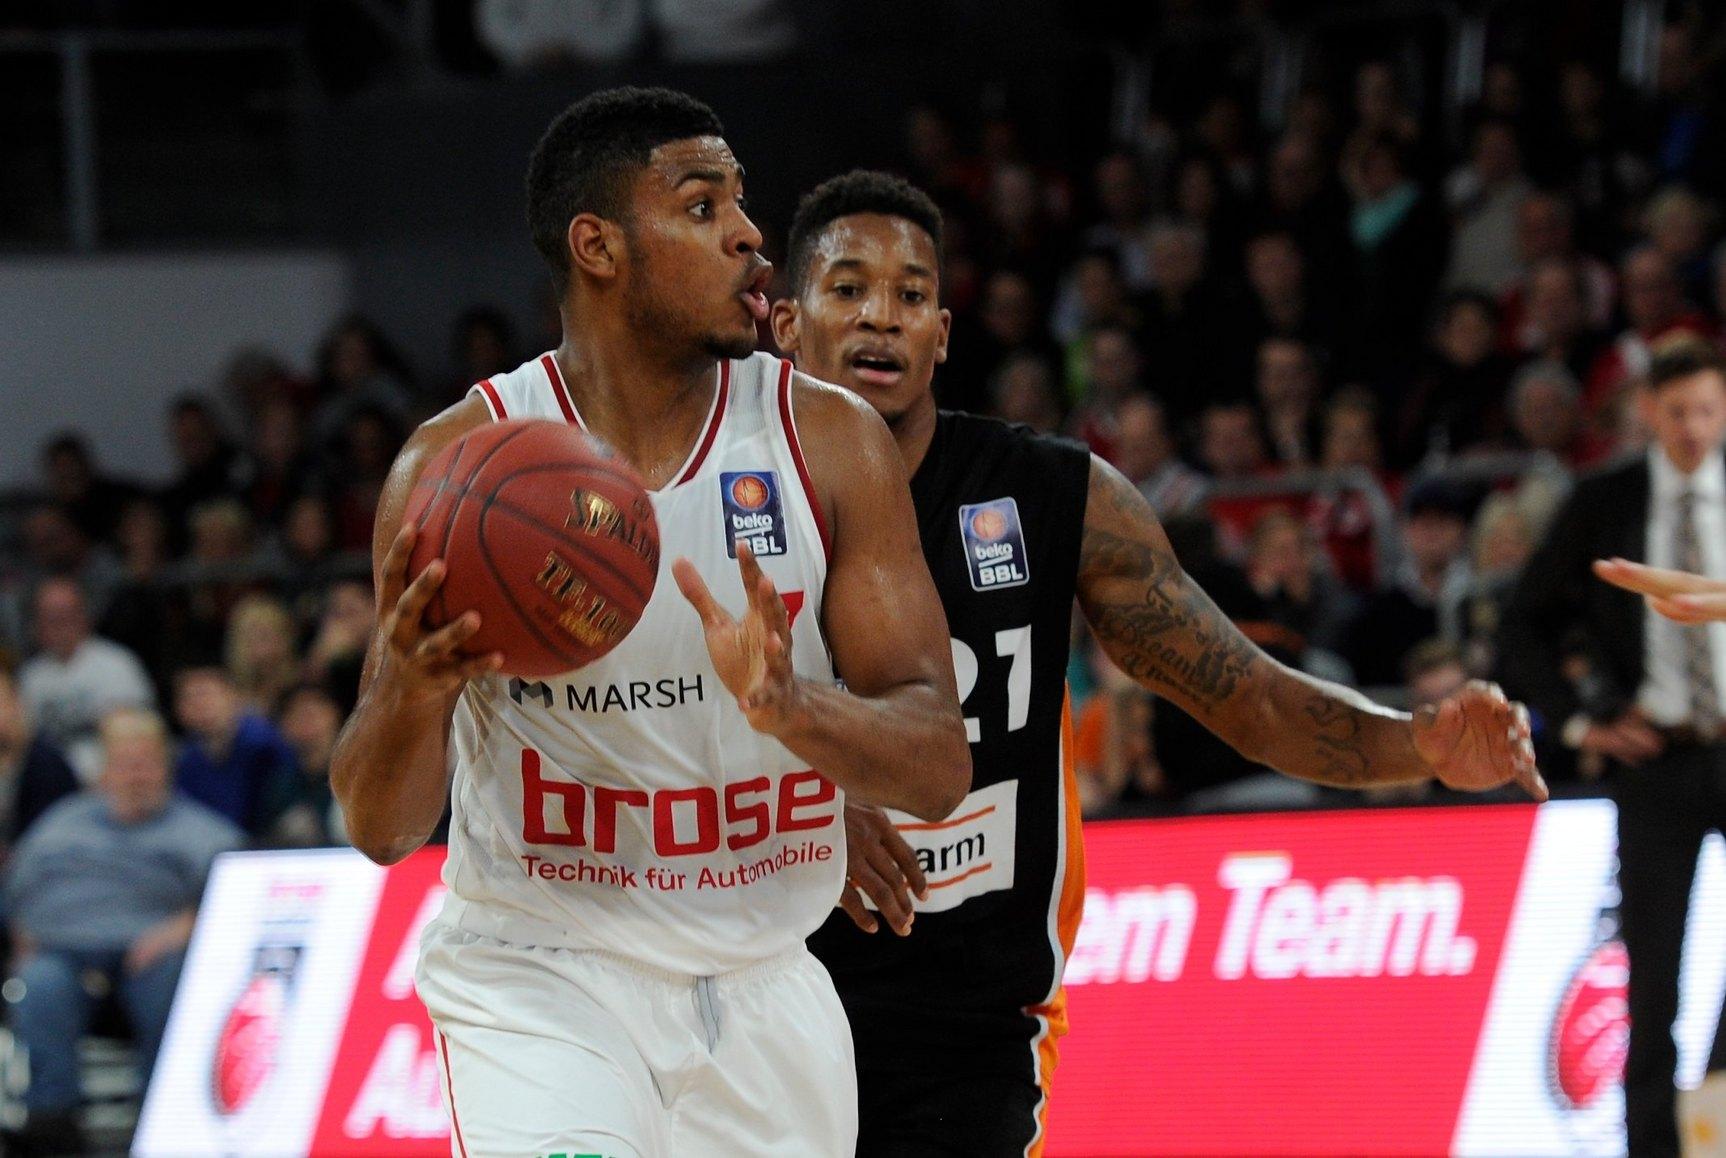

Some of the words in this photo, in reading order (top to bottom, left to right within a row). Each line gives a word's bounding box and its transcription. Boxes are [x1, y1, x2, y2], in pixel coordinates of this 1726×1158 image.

[732, 512, 773, 530] beko
[974, 542, 1013, 560] beko
[979, 564, 1024, 586] BBL
[566, 674, 704, 713] MARSH
[521, 747, 837, 857] brose
[521, 855, 638, 888] Technik
[645, 867, 687, 891] für
[696, 842, 833, 891] Automobile
[915, 832, 986, 874] arm
[1062, 883, 1198, 985] em
[1213, 850, 1478, 981] Team.
